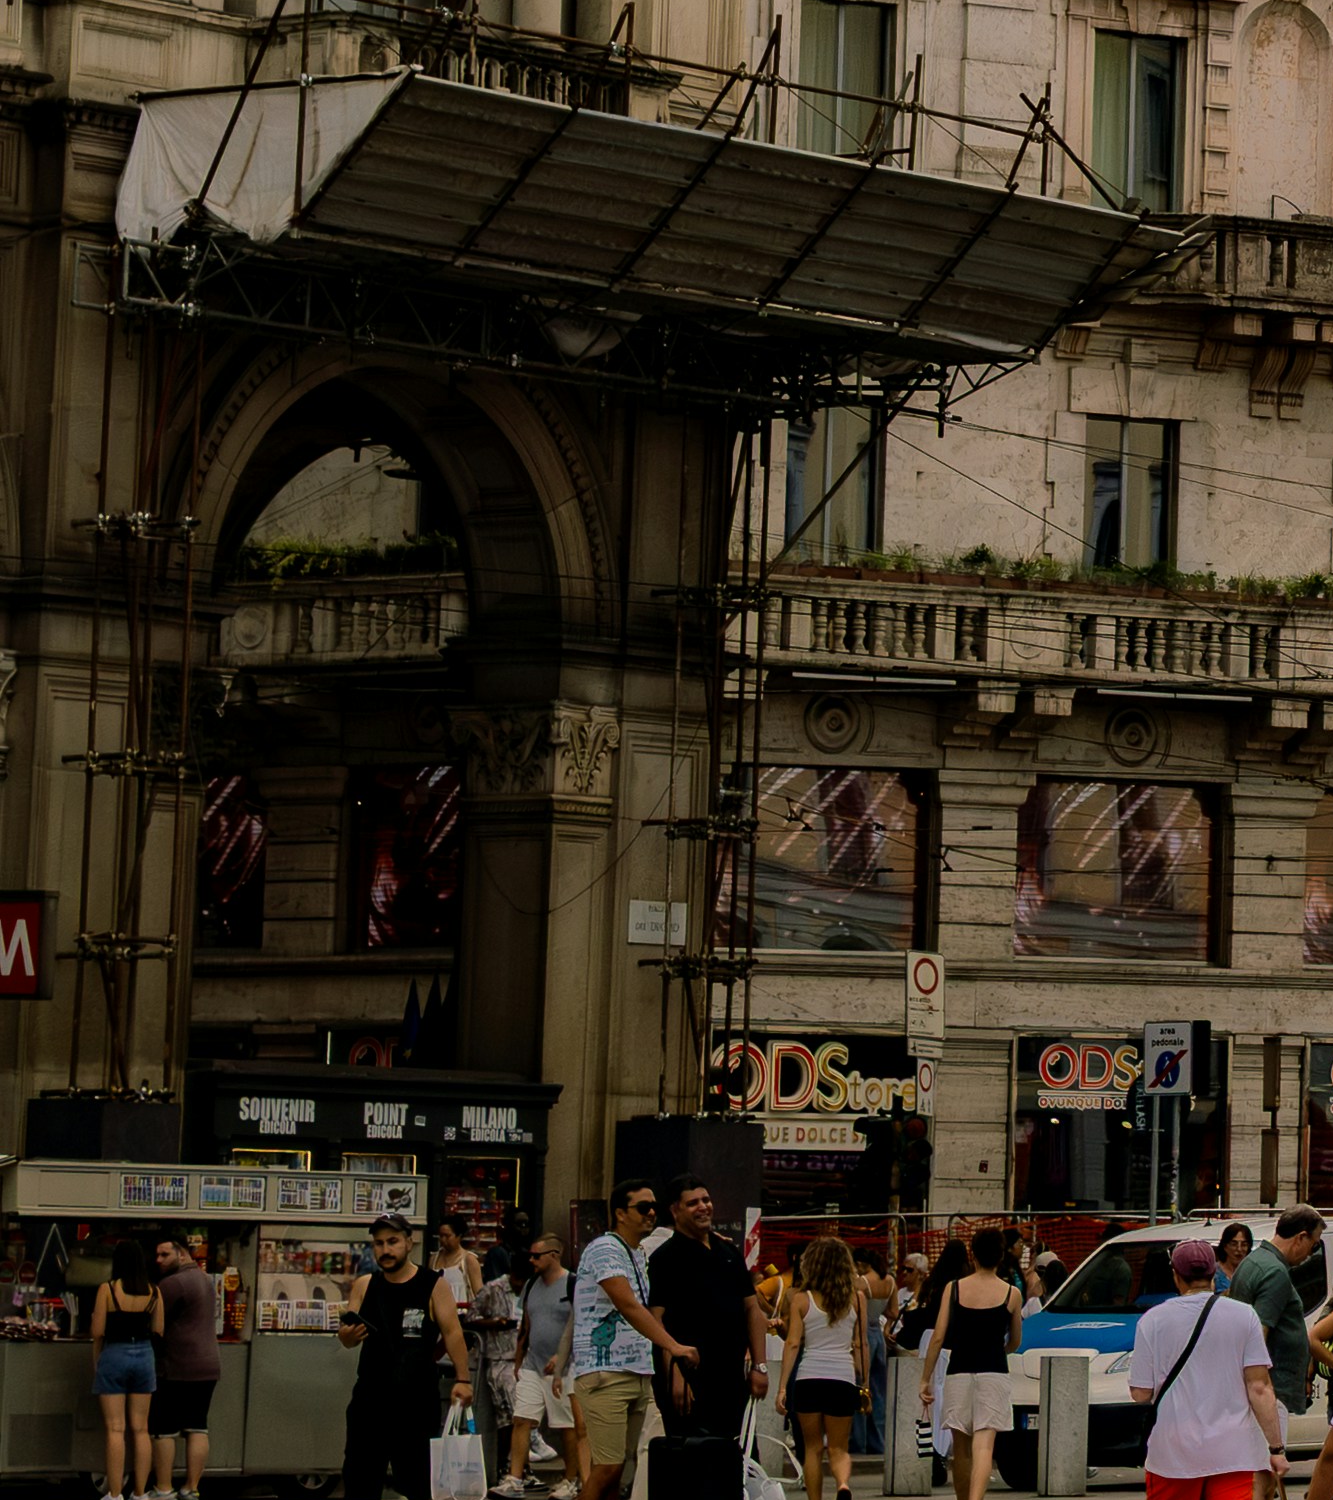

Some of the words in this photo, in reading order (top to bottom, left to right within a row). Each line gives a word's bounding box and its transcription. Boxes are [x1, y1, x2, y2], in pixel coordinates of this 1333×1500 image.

[1159, 1027, 1176, 1035] area
[1151, 1038, 1185, 1047] pedonale
[239, 1096, 316, 1123] SOUVENIR
[1038, 1096, 1101, 1111] OVUNQUE
[363, 1101, 409, 1126] POINT
[462, 1105, 518, 1129] MILANO
[258, 1119, 297, 1136] EDICOLA
[366, 1125, 402, 1140] EDICOLA
[470, 1128, 506, 1143] EDICOLA
[796, 1126, 847, 1144] DOLCE
